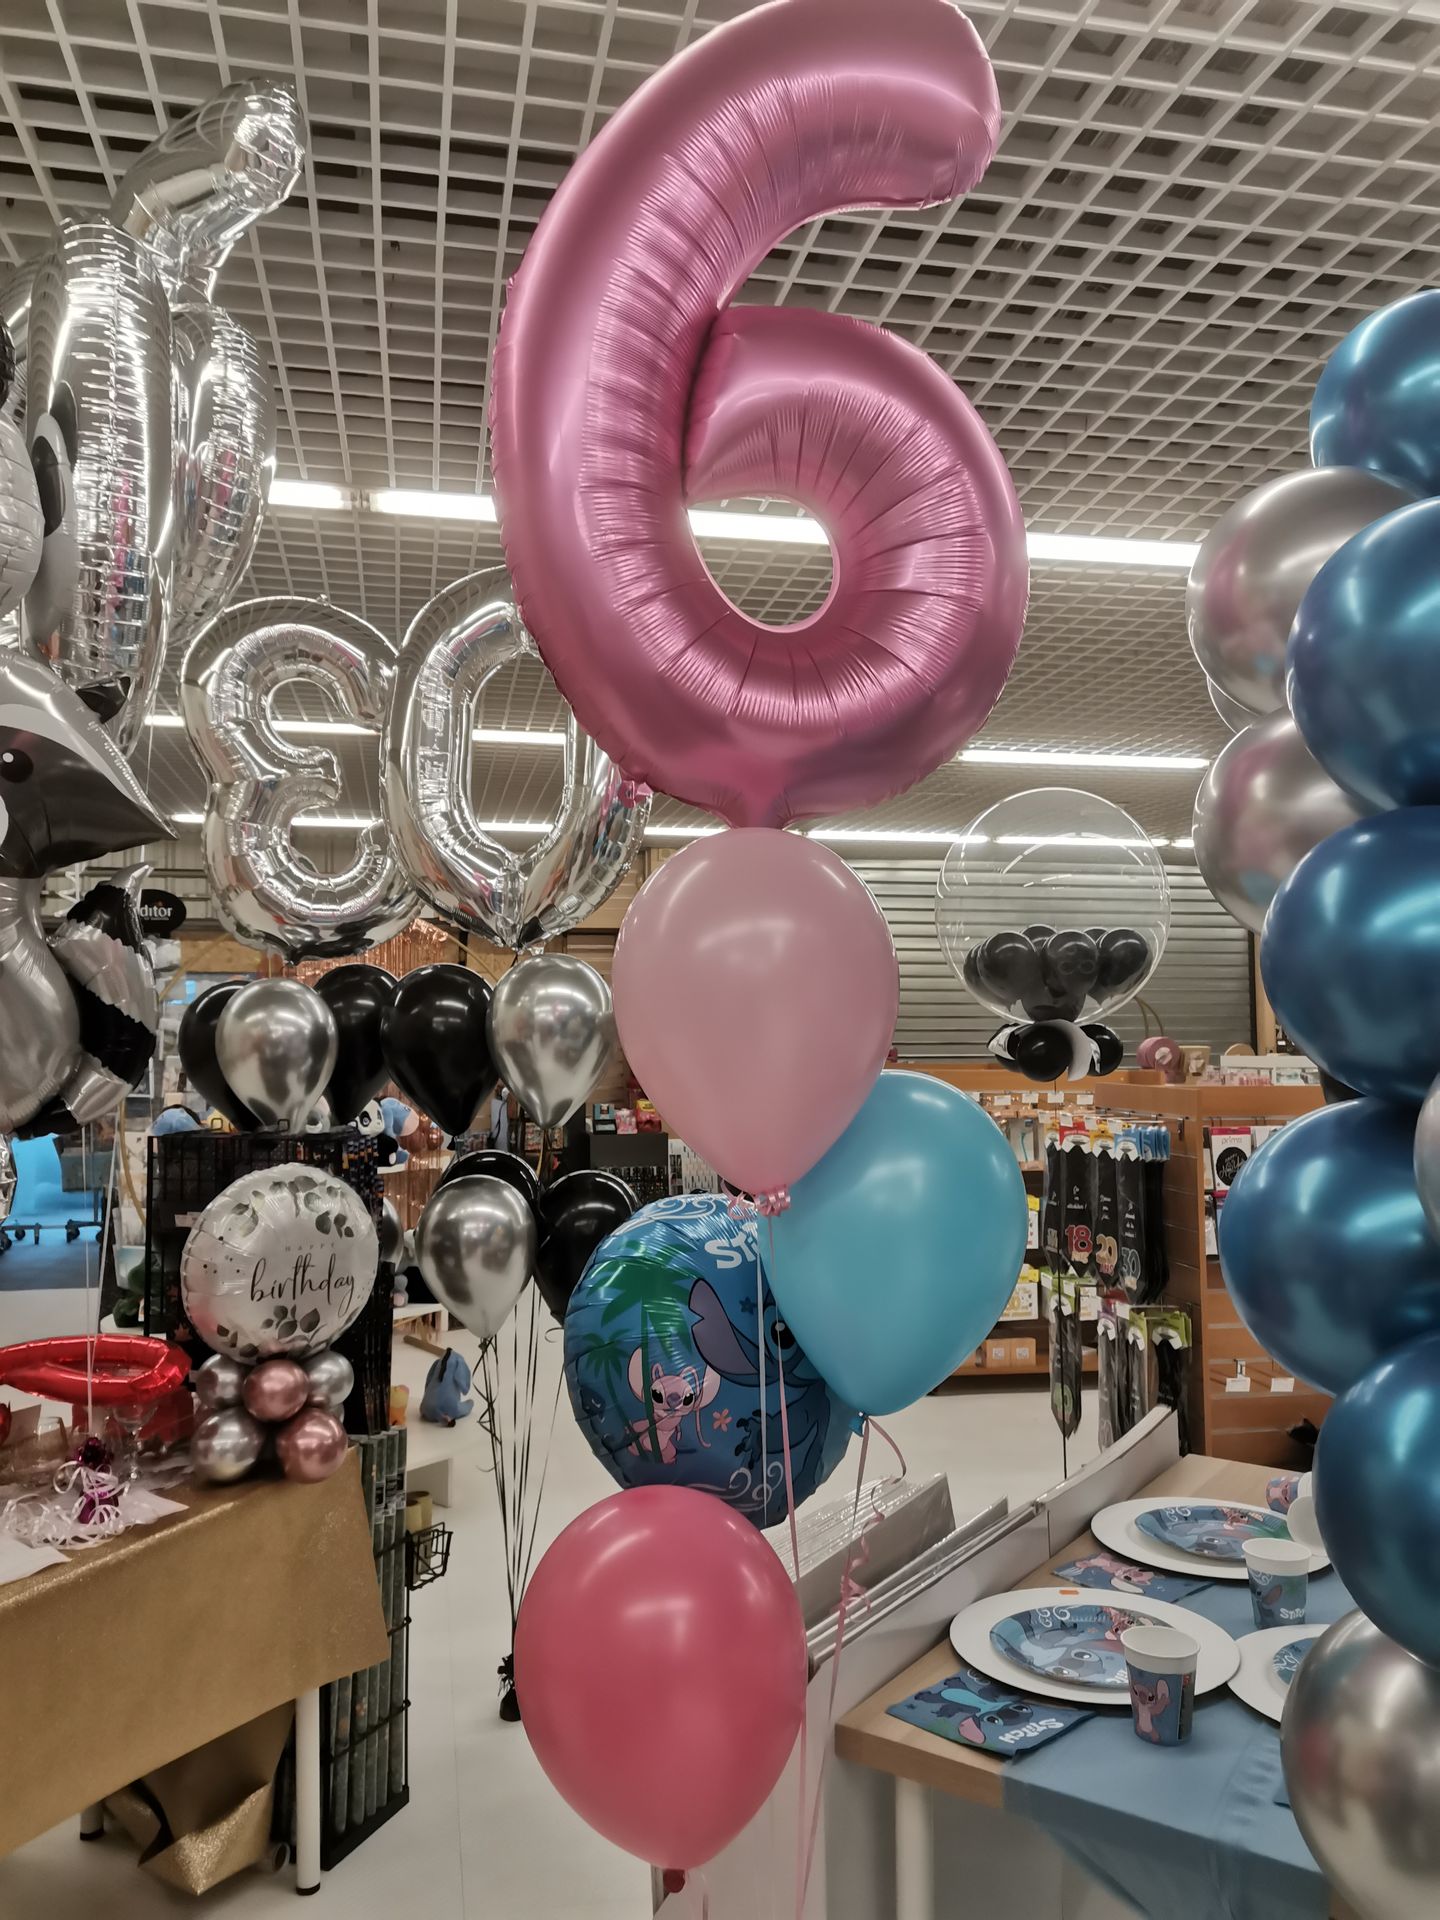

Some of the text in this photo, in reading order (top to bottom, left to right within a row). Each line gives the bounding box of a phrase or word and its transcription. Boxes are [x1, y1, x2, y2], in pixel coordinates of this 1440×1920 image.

[490, 0, 1028, 826] 6
[140, 904, 173, 918] ditor
[1065, 1225, 1093, 1255] 18
[1095, 1234, 1118, 1265] 20
[1121, 1247, 1141, 1281] 30
[250, 1253, 355, 1318] birthday
